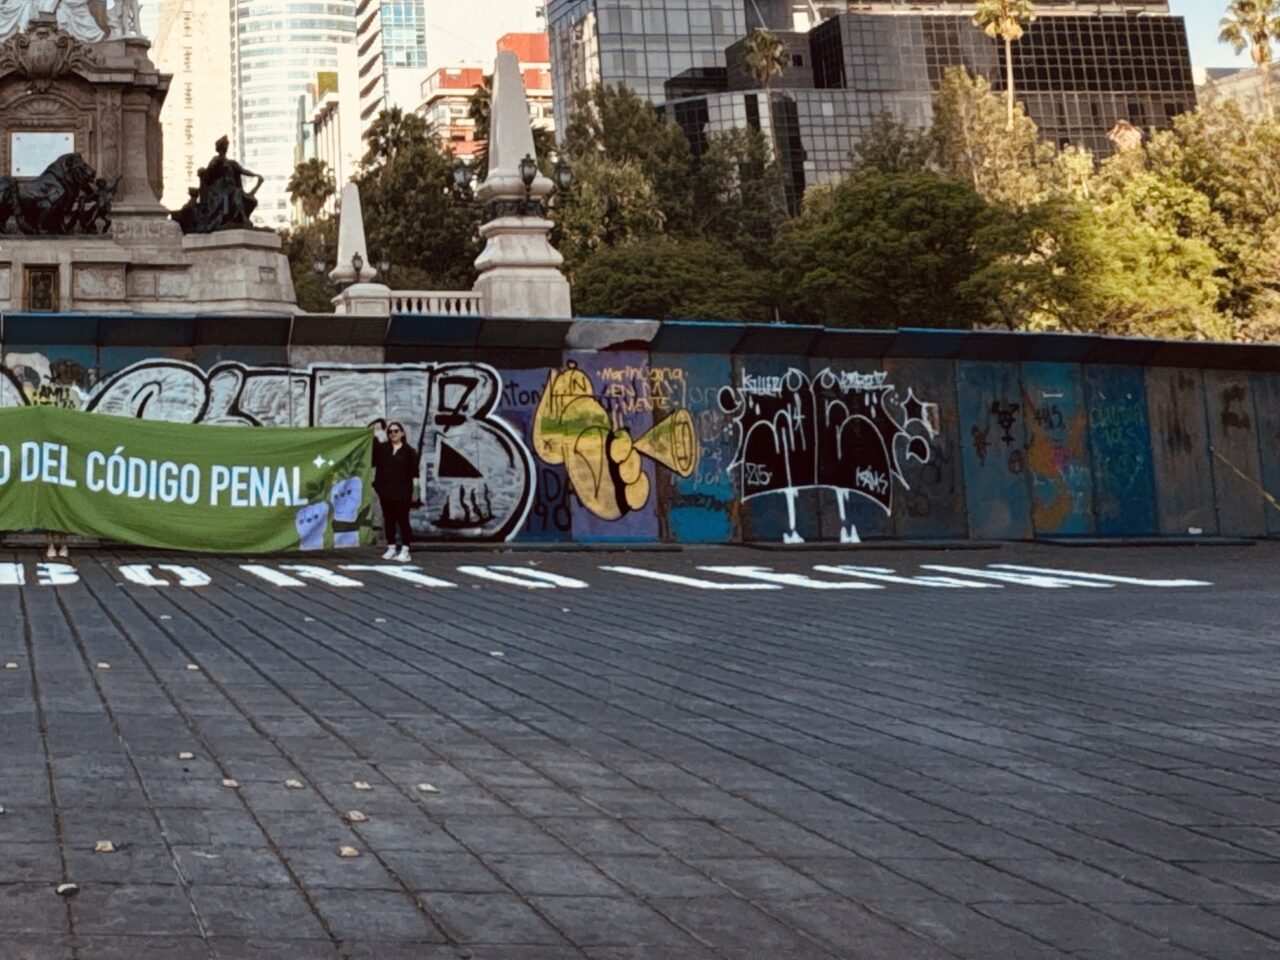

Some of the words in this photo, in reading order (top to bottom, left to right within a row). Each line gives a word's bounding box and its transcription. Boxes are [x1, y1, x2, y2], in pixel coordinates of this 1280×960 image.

[21, 441, 76, 488] DEL
[85, 446, 201, 505] CÓDIGO
[210, 465, 308, 507] PENAL
[598, 563, 1212, 589] LEGAL
